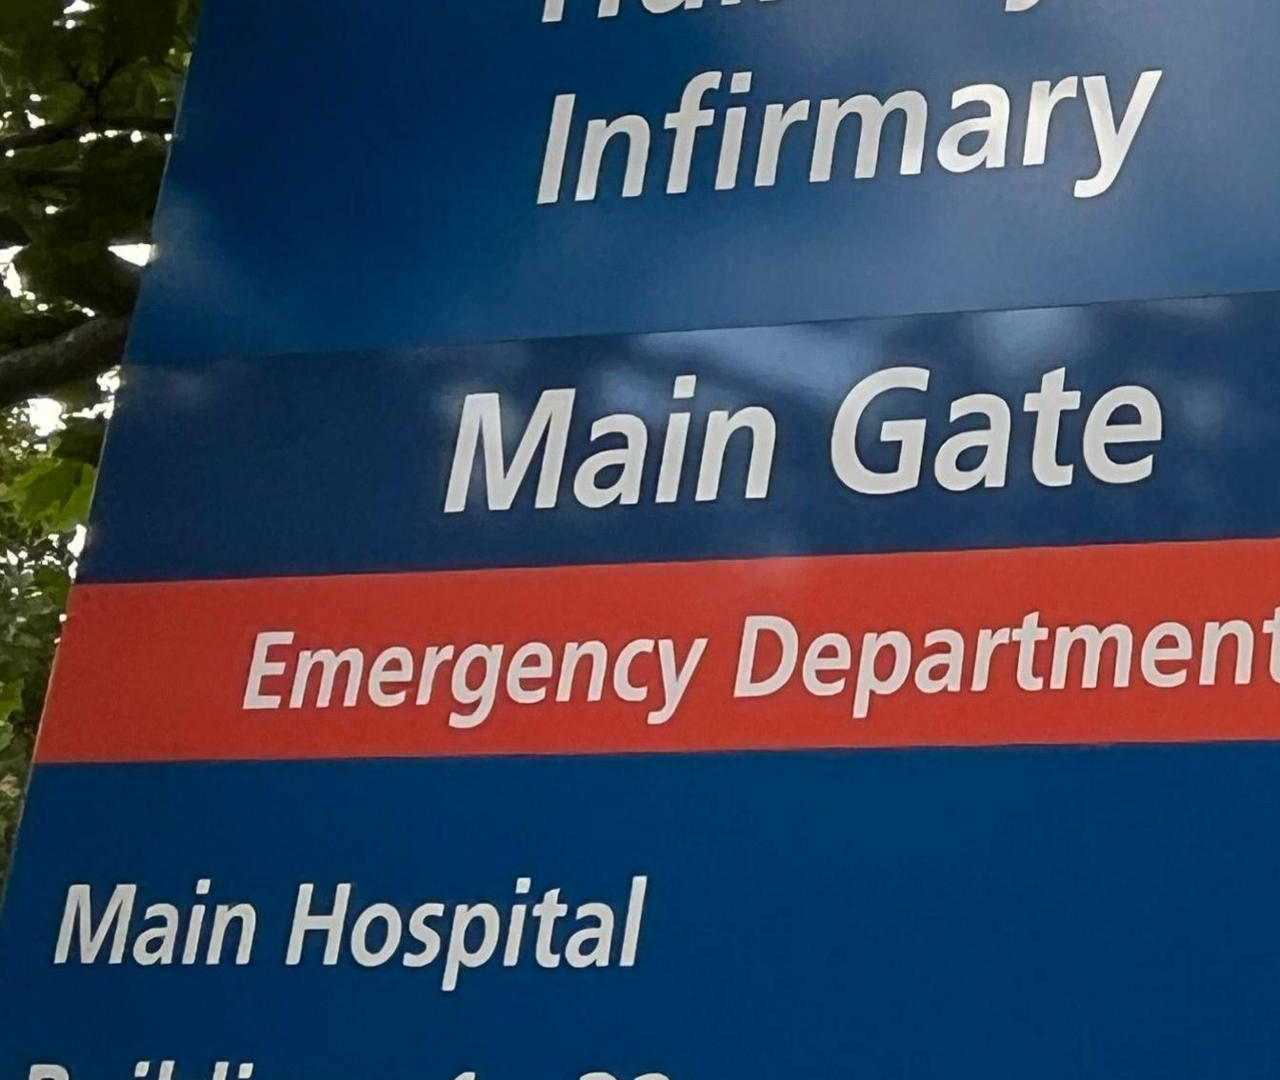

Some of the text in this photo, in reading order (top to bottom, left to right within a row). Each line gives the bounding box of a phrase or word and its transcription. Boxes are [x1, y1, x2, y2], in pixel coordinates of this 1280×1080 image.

[537, 71, 1163, 204] Infirmary
[444, 366, 1162, 513] Main Gate
[242, 631, 708, 729] Emergency
[54, 875, 647, 992] Main Hospital
